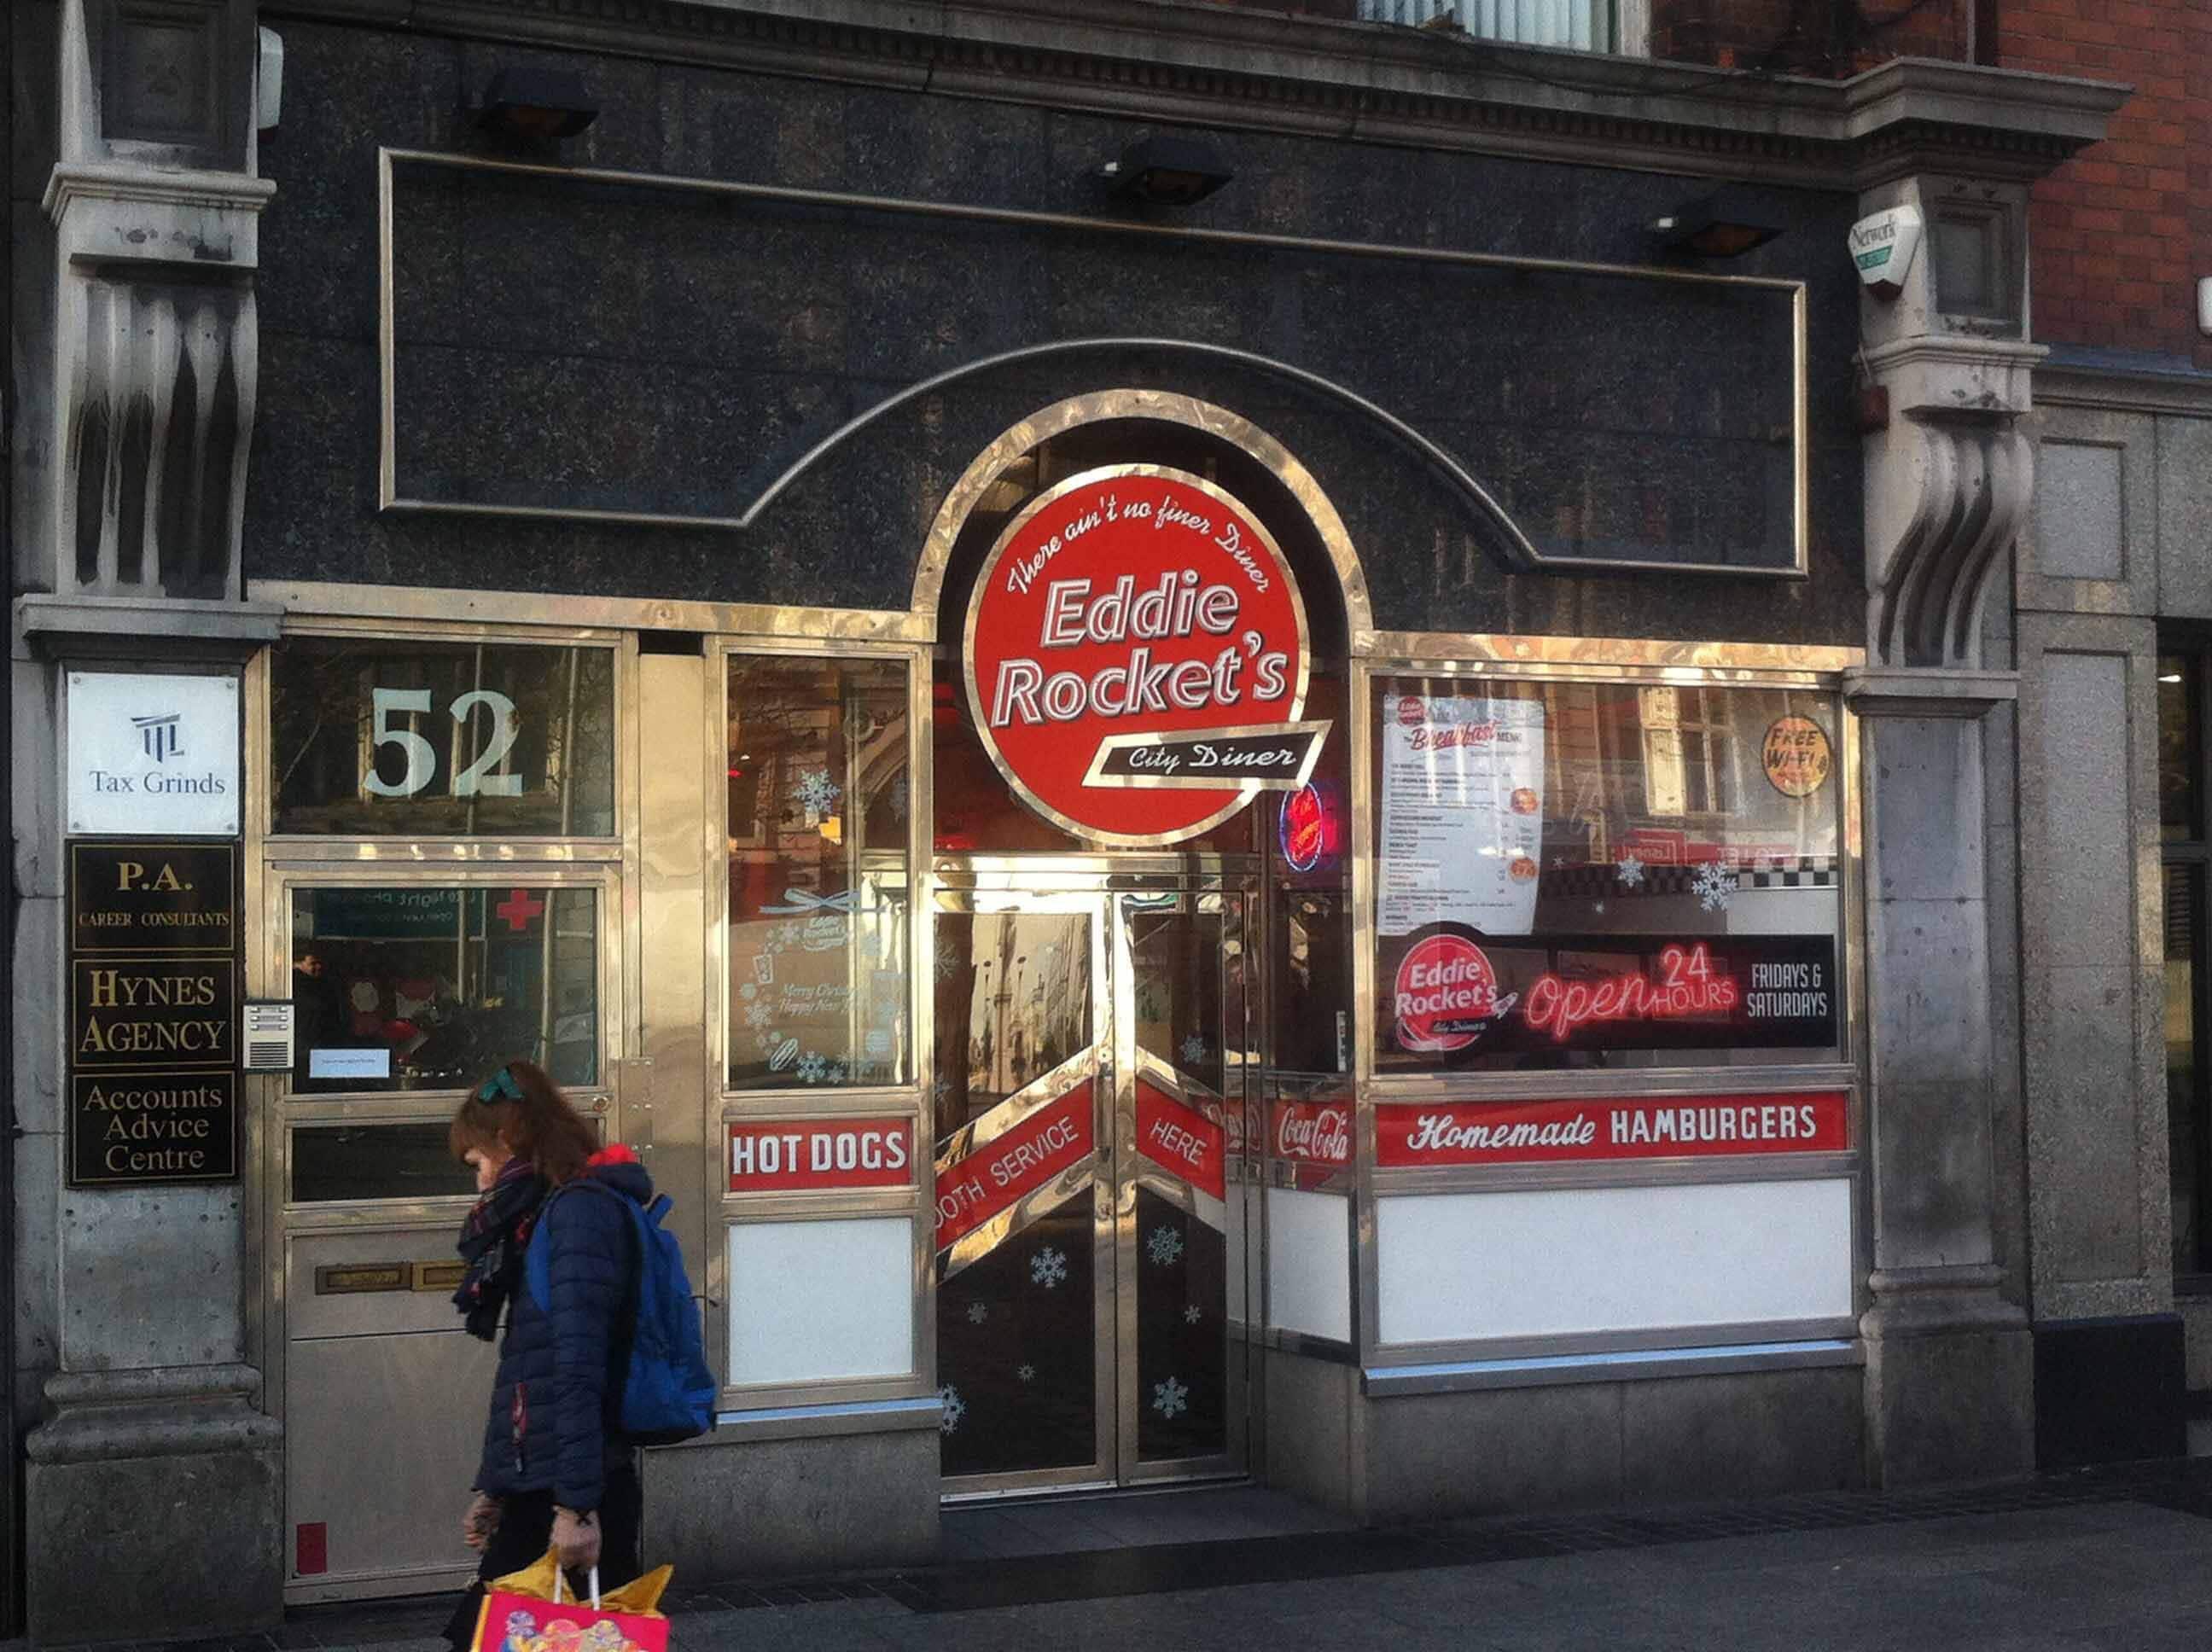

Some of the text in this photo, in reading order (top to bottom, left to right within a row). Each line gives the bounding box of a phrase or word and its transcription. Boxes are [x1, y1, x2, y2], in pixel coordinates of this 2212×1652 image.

[1007, 493, 1270, 595] There ain't no finer Diner
[1041, 569, 1239, 648] Eddie
[991, 630, 1288, 728] Rocket's
[363, 687, 523, 798] 52
[1770, 727, 1818, 747] FREE
[1129, 744, 1297, 775] City Diner
[89, 770, 226, 795] Tax Grinds
[116, 861, 194, 892] P.A.
[79, 911, 230, 928] CAREER CONSULTANTS
[1410, 957, 1481, 989] Eddie
[1664, 946, 1708, 986] 24
[1751, 963, 1822, 988] FRIDAYS &
[1394, 979, 1499, 1018] Rocket's
[1528, 978, 1736, 1038] Open HOURS
[1747, 991, 1828, 1018] SATURDAYS
[84, 1084, 223, 1111] Accounts
[103, 1111, 210, 1141] Advice
[1149, 1117, 1208, 1166] HERE
[1278, 1107, 1348, 1160] Coca-Cola
[1407, 1105, 1817, 1150] Homemade HAMBURGERS
[105, 1143, 205, 1173] Centre
[732, 1131, 907, 1175] HOT DOGS
[989, 1115, 1080, 1187] SERVICE
